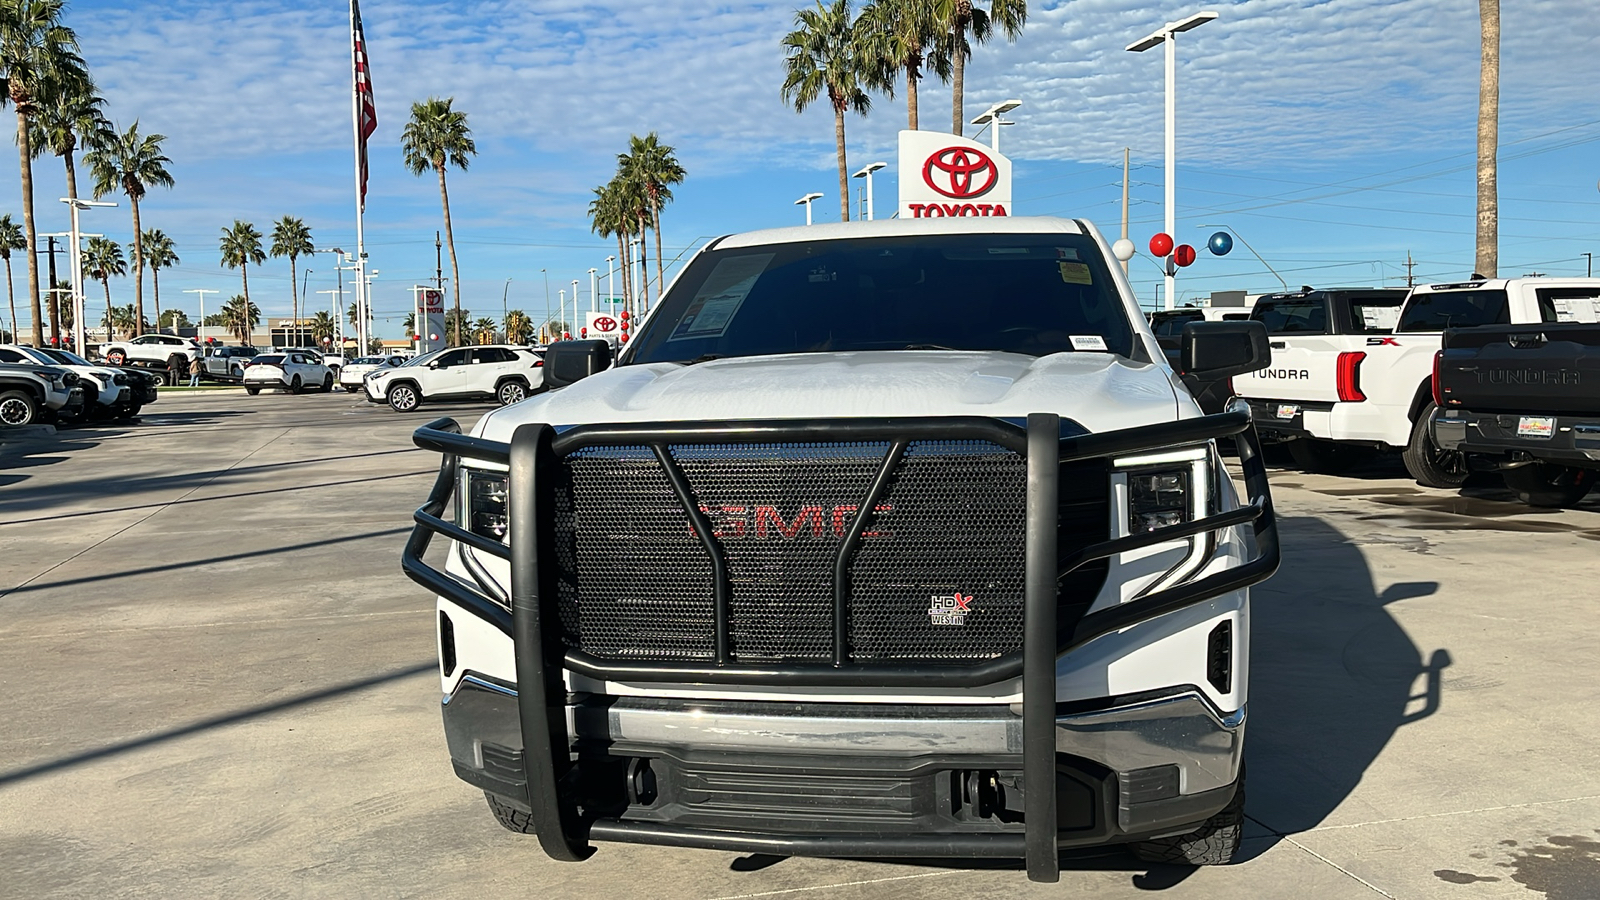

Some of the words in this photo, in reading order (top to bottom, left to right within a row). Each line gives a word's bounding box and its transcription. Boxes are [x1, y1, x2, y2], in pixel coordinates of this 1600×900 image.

[908, 203, 1008, 218] TOYOTA
[1473, 369, 1581, 384] TUNDRA
[688, 504, 894, 538] GMC
[931, 592, 973, 611] HDX
[931, 615, 964, 625] WESTIN
